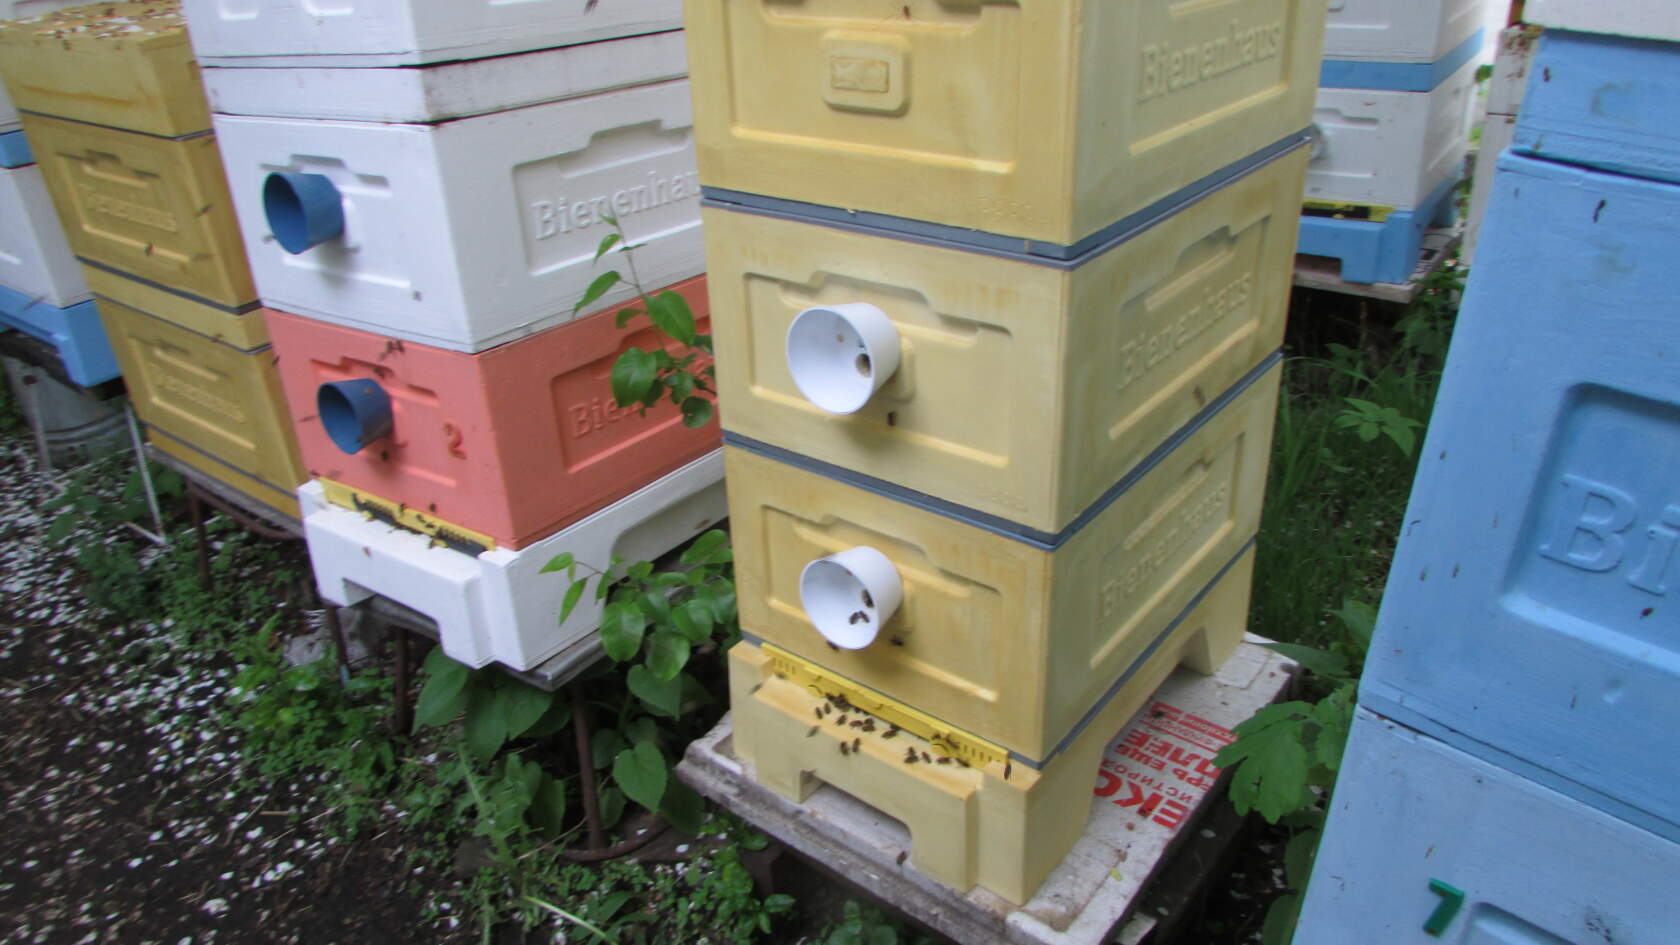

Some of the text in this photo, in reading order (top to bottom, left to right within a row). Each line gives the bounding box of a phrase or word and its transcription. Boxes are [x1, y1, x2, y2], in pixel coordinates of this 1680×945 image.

[1138, 19, 1280, 104] Bienenhaus
[1118, 272, 1249, 391] Bienenhaus
[1423, 877, 1465, 938] 7
